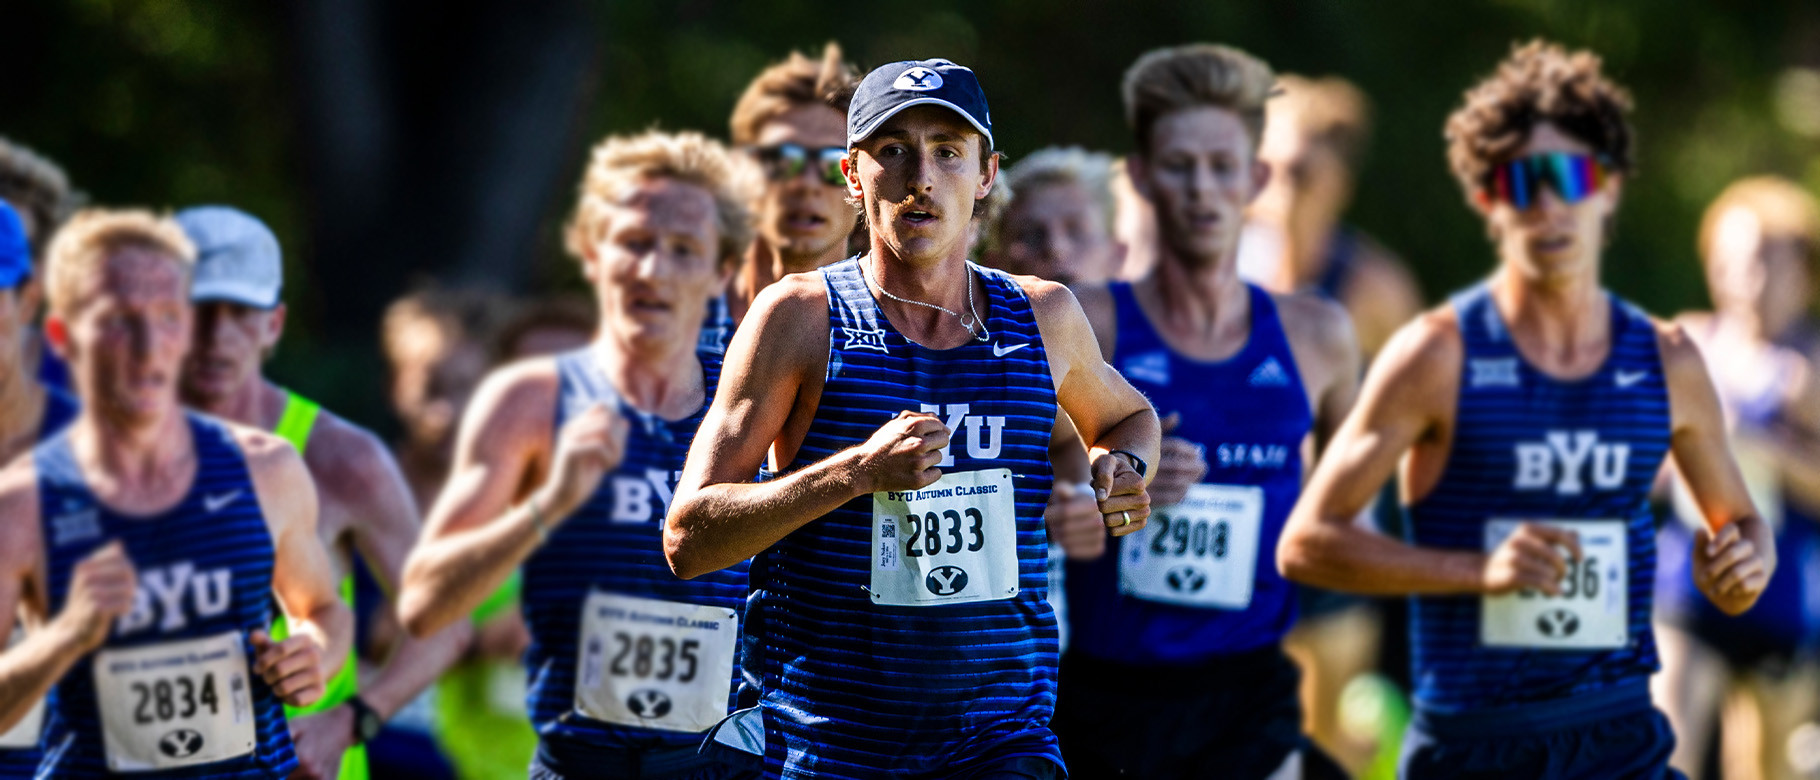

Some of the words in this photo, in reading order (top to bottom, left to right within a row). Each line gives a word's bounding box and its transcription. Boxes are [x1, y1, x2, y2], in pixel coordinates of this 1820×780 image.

[892, 403, 1006, 467] YU
[1514, 432, 1630, 494] BYU
[888, 491, 913, 502] BYU
[915, 488, 953, 501] AUTUMN
[955, 485, 998, 496] CLASSIC
[906, 508, 985, 557] 2833
[1151, 513, 1231, 560] 2908
[928, 567, 966, 595] Y
[609, 631, 701, 683] 2835
[131, 672, 220, 726] 2834
